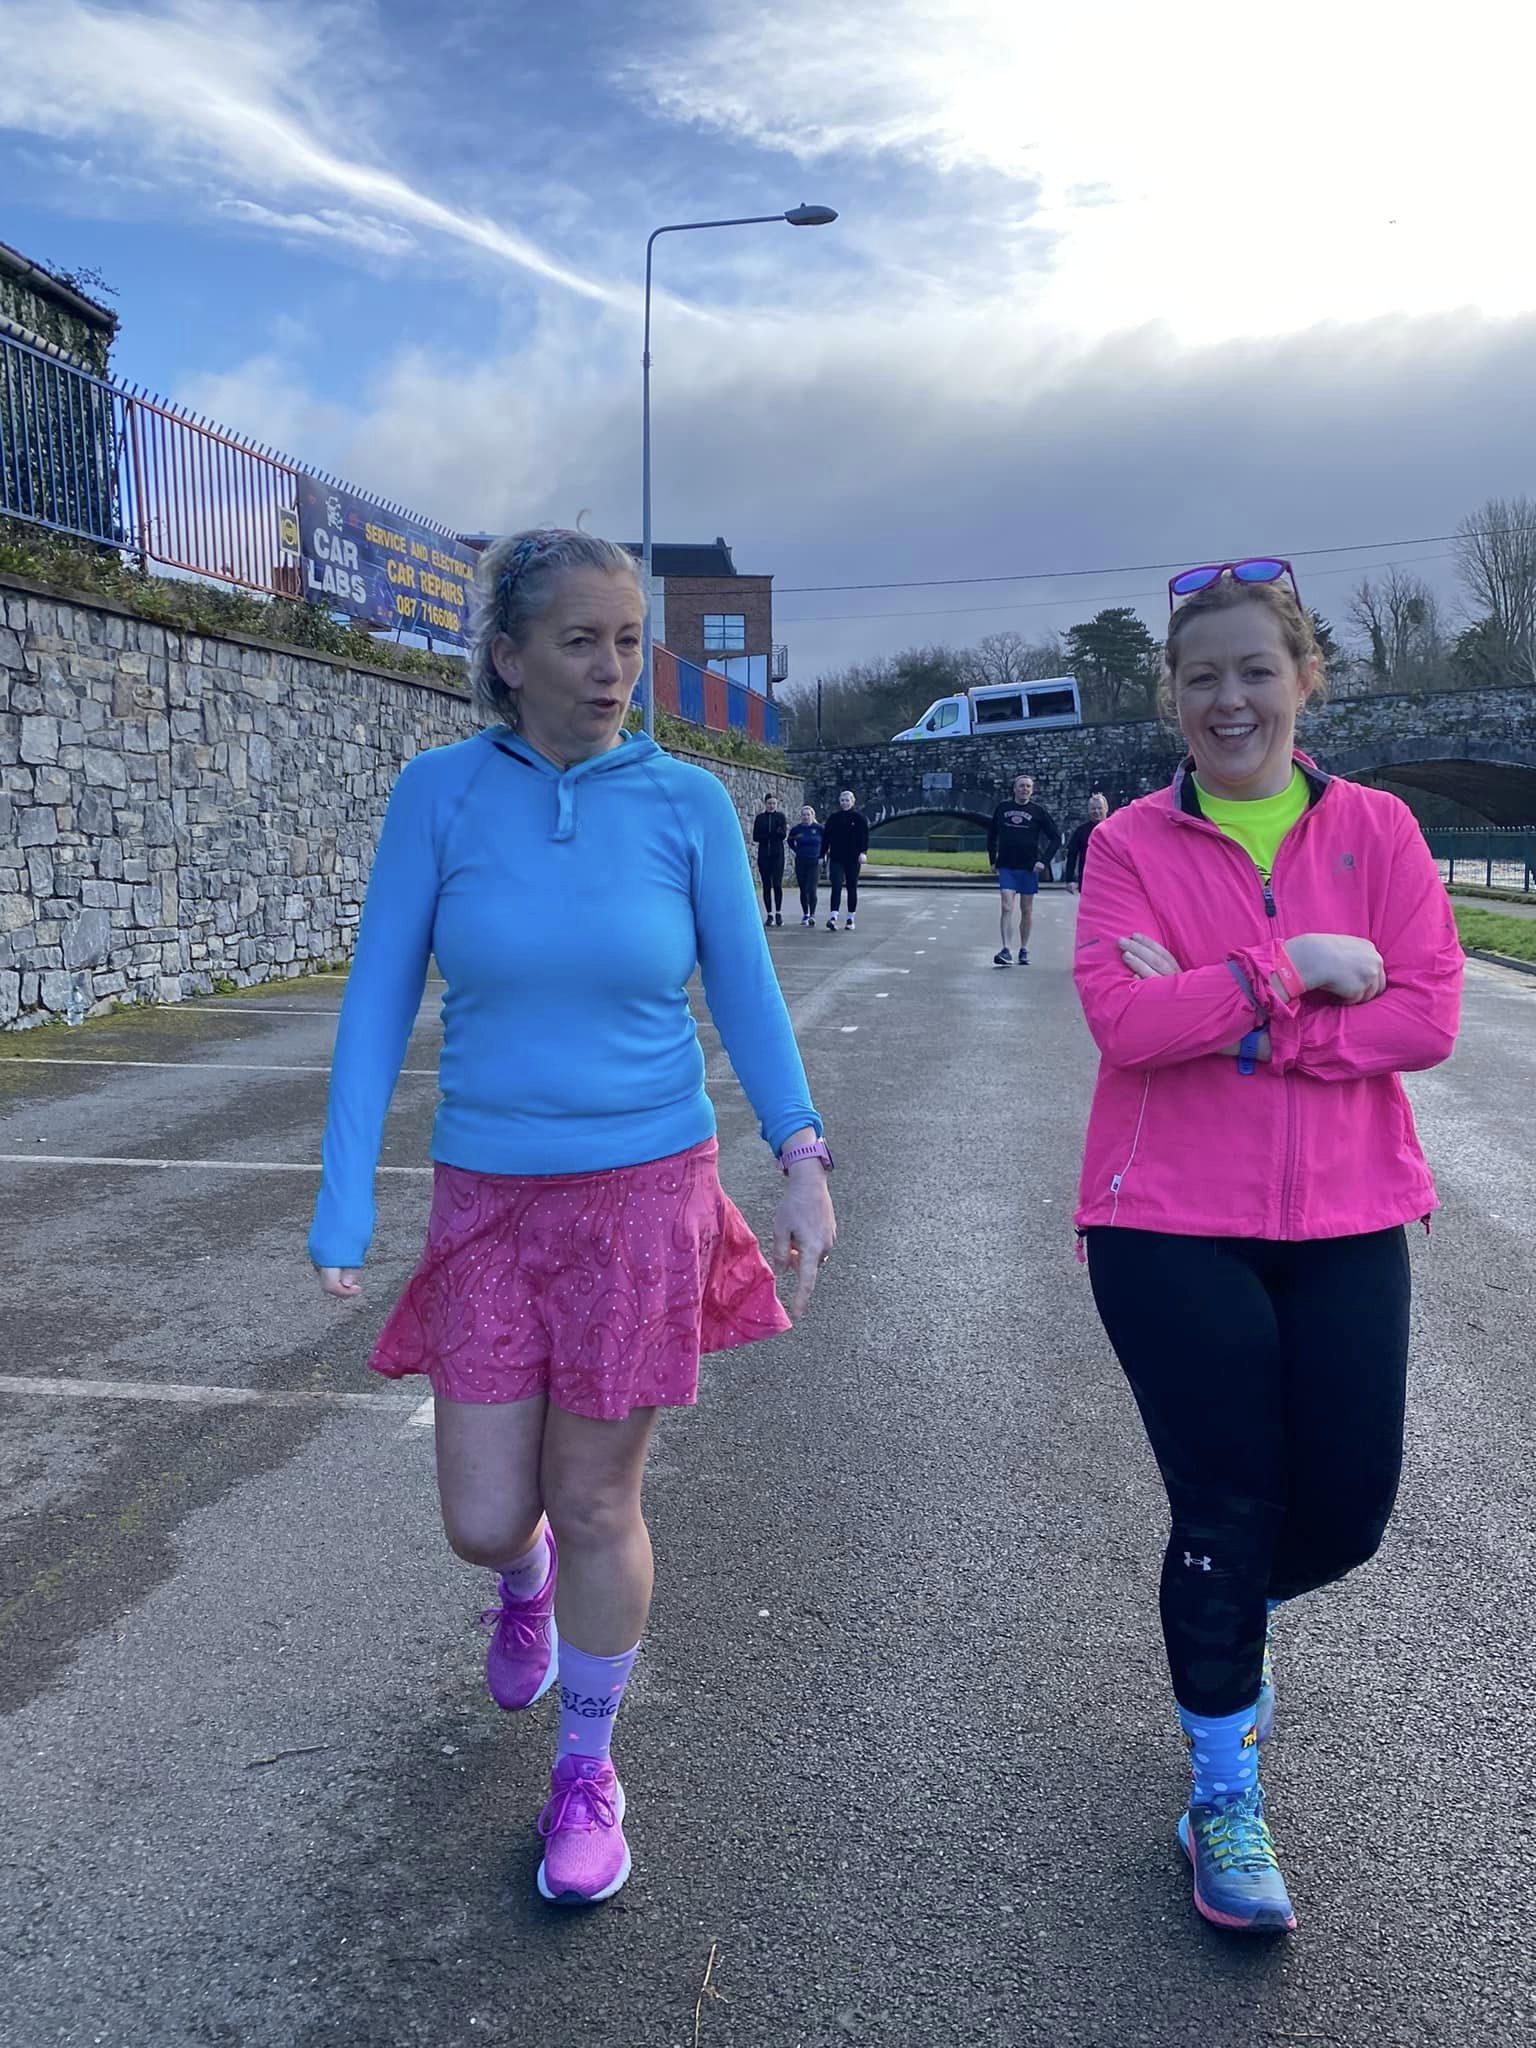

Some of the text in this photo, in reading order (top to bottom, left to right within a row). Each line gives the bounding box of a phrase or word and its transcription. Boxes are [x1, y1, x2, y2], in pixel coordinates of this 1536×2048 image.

[314, 528, 359, 570] CAR
[365, 522, 407, 554] SERVICE
[411, 541, 428, 562] AND
[307, 559, 367, 604] LABS
[387, 559, 465, 606] CAR REPAIRS
[396, 594, 417, 618] 087
[562, 1687, 612, 1706] STAY
